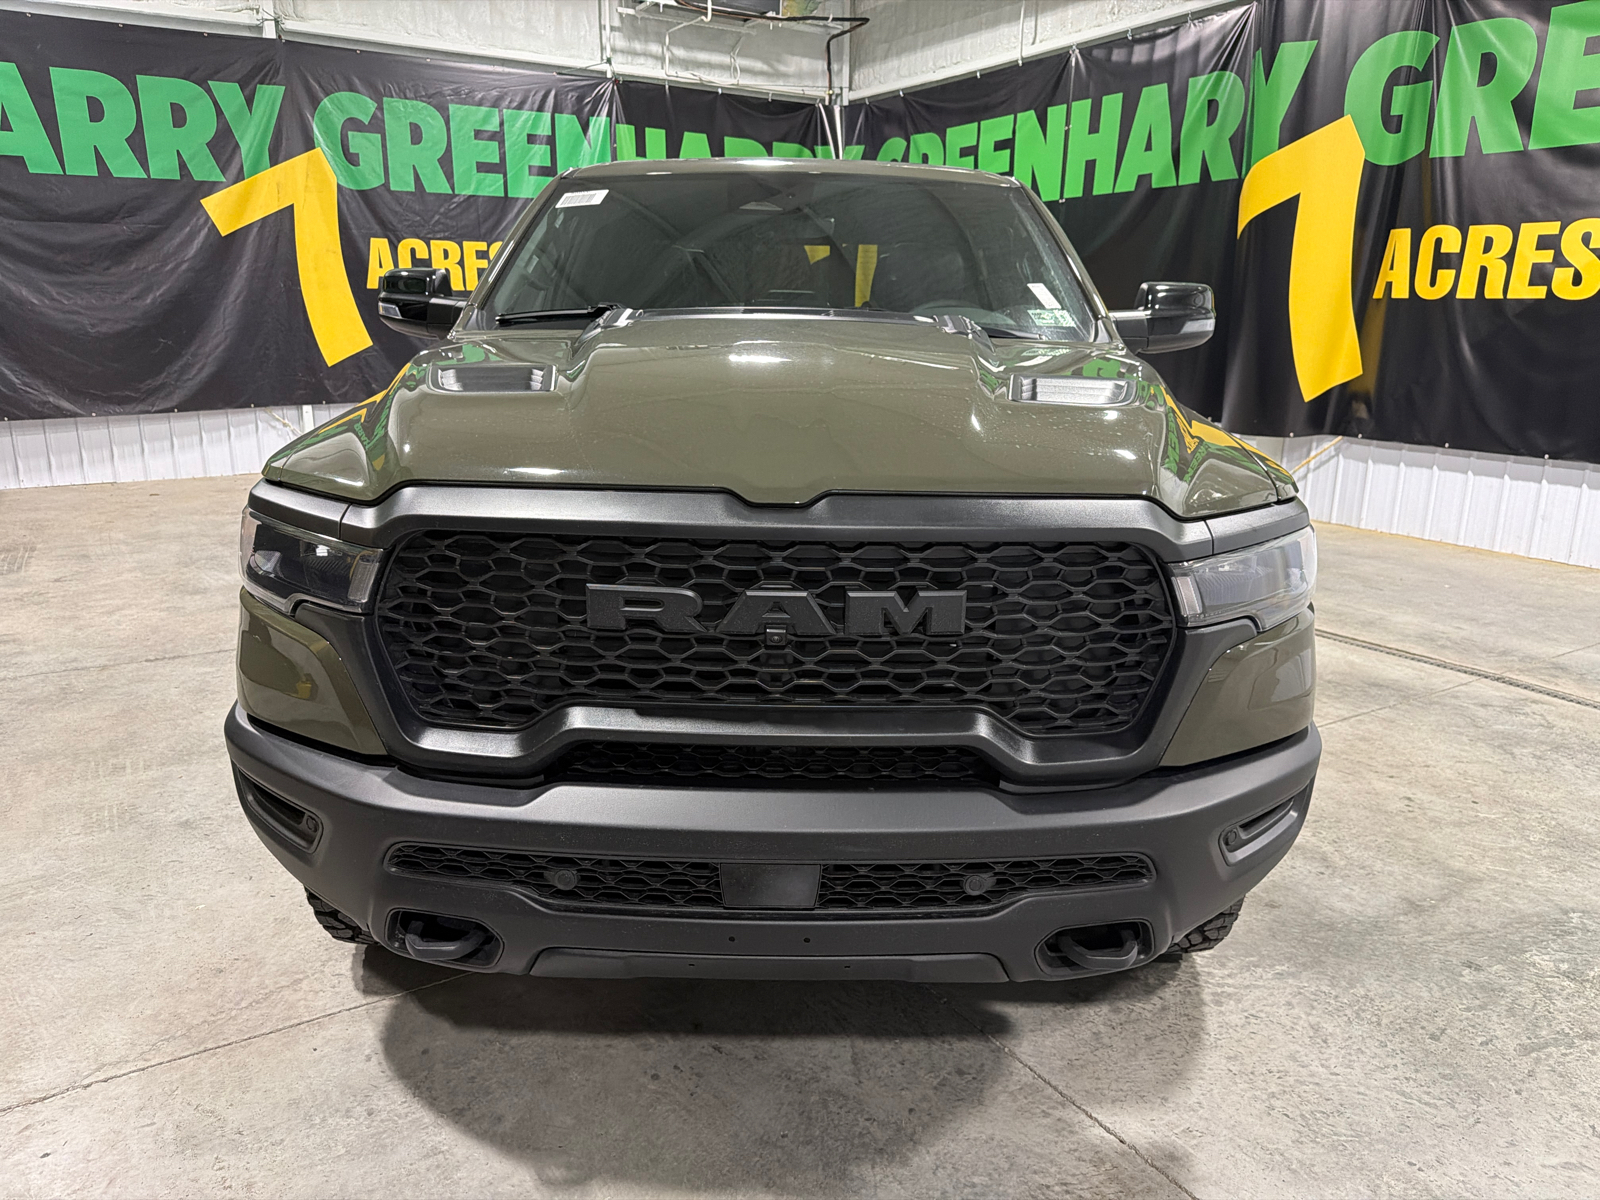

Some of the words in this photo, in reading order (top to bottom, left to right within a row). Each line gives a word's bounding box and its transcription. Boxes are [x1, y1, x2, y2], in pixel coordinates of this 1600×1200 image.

[200, 147, 373, 367] 7
[366, 237, 503, 291] ACRE
[1238, 114, 1366, 402] 7
[1372, 217, 1600, 300] ACRES
[586, 583, 968, 635] RAM
